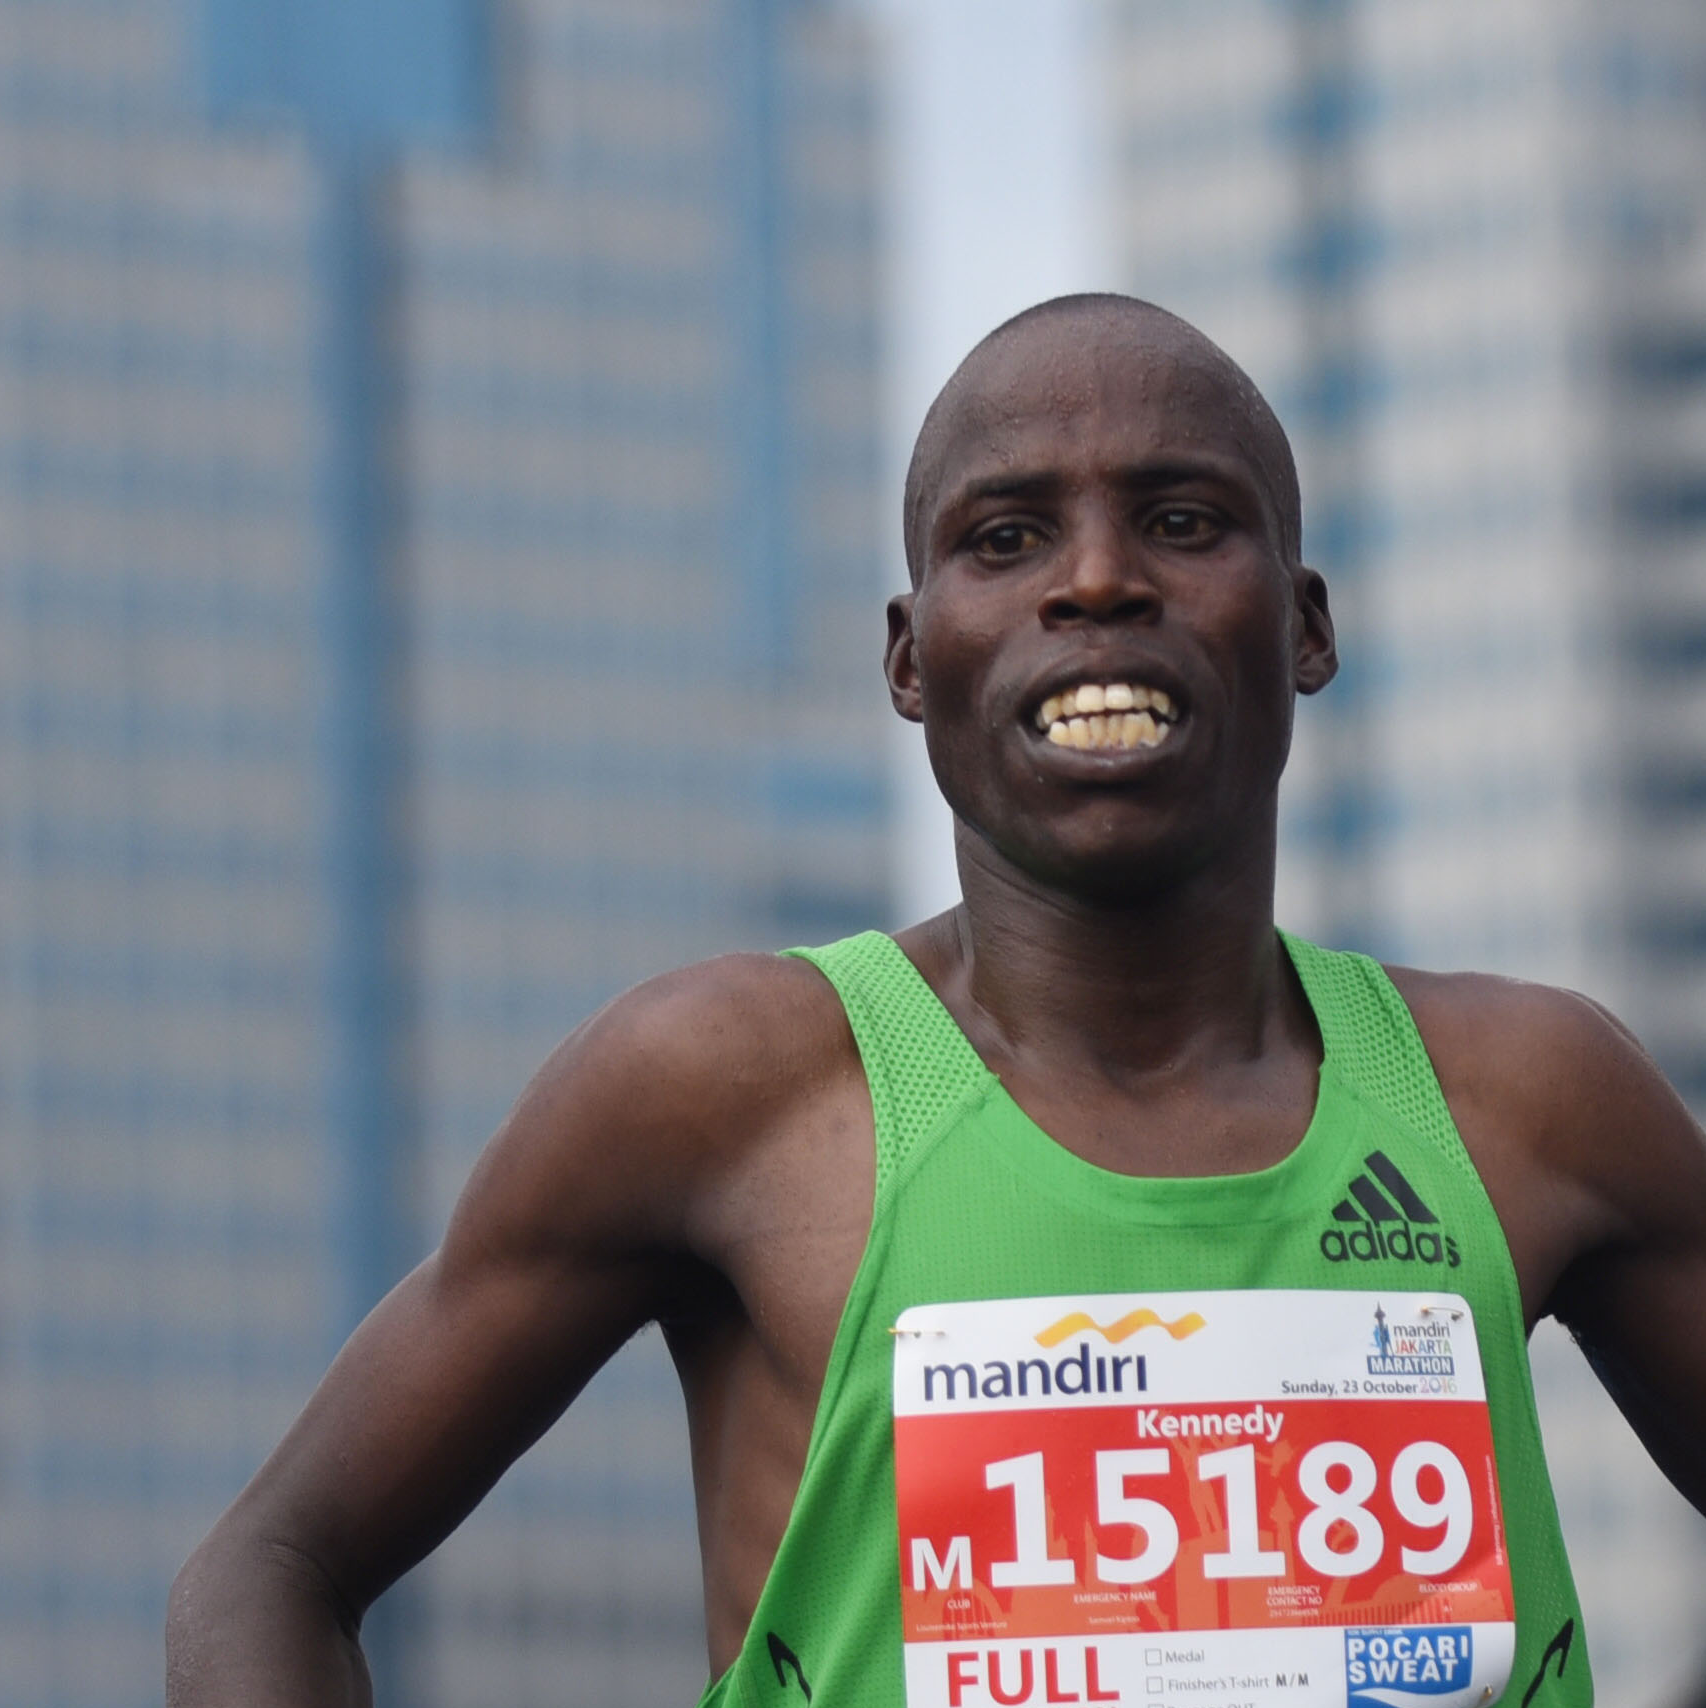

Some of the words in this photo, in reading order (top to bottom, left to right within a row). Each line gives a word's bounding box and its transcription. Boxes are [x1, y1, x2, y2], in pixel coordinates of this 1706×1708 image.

[1320, 1219, 1461, 1268] adidas
[1393, 1321, 1451, 1338] mandiri
[1395, 1339, 1453, 1355] JAKARTA
[923, 1342, 1148, 1402] mandiri
[1370, 1356, 1452, 1374] MARATHON
[1281, 1380, 1338, 1396] Sunday,
[1343, 1380, 1359, 1394] 23
[1363, 1380, 1417, 1394] October
[1420, 1377, 1458, 1394] 2016
[1136, 1404, 1284, 1443] Kennedy
[910, 1535, 973, 1592] M
[984, 1440, 1474, 1589] 15189
[1267, 1585, 1321, 1596] EMERGENCY
[1418, 1582, 1447, 1594] BLOOD
[1447, 1581, 1478, 1593] GROUP
[947, 1599, 971, 1610] CLUB
[1073, 1591, 1128, 1604] EMERGENCY
[1130, 1590, 1157, 1602] NAME
[1266, 1595, 1307, 1607] CONTACT
[1308, 1595, 1323, 1606] NO
[1347, 1635, 1469, 1661] POCARI
[1165, 1650, 1205, 1664] Medal
[947, 1646, 1120, 1708] FULL
[1348, 1658, 1459, 1684] SWEAT
[1168, 1676, 1226, 1691] Finisher's
[1229, 1675, 1270, 1690] T-shirt
